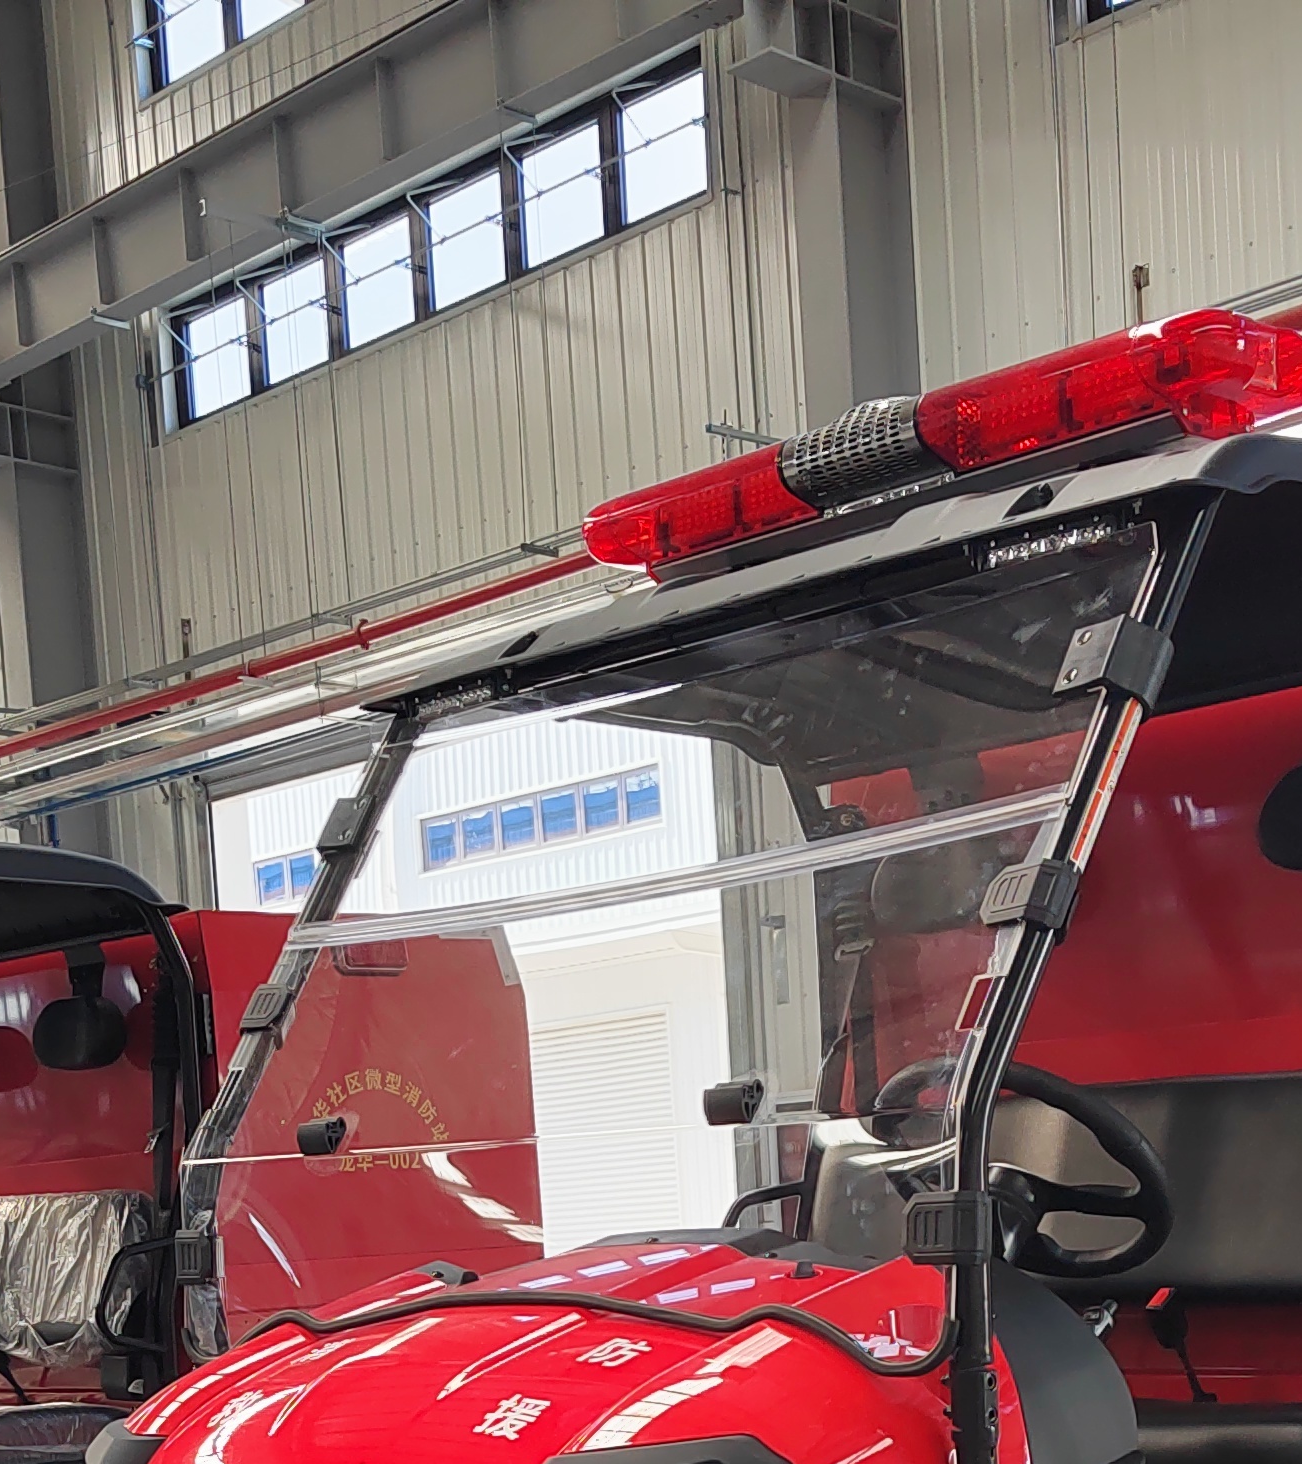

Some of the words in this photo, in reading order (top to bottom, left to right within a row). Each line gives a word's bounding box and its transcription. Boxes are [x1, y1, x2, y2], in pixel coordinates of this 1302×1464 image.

[312, 1068, 449, 1142] 华社区微型消防站
[575, 1336, 652, 1368] 防
[472, 1393, 551, 1441] 援
